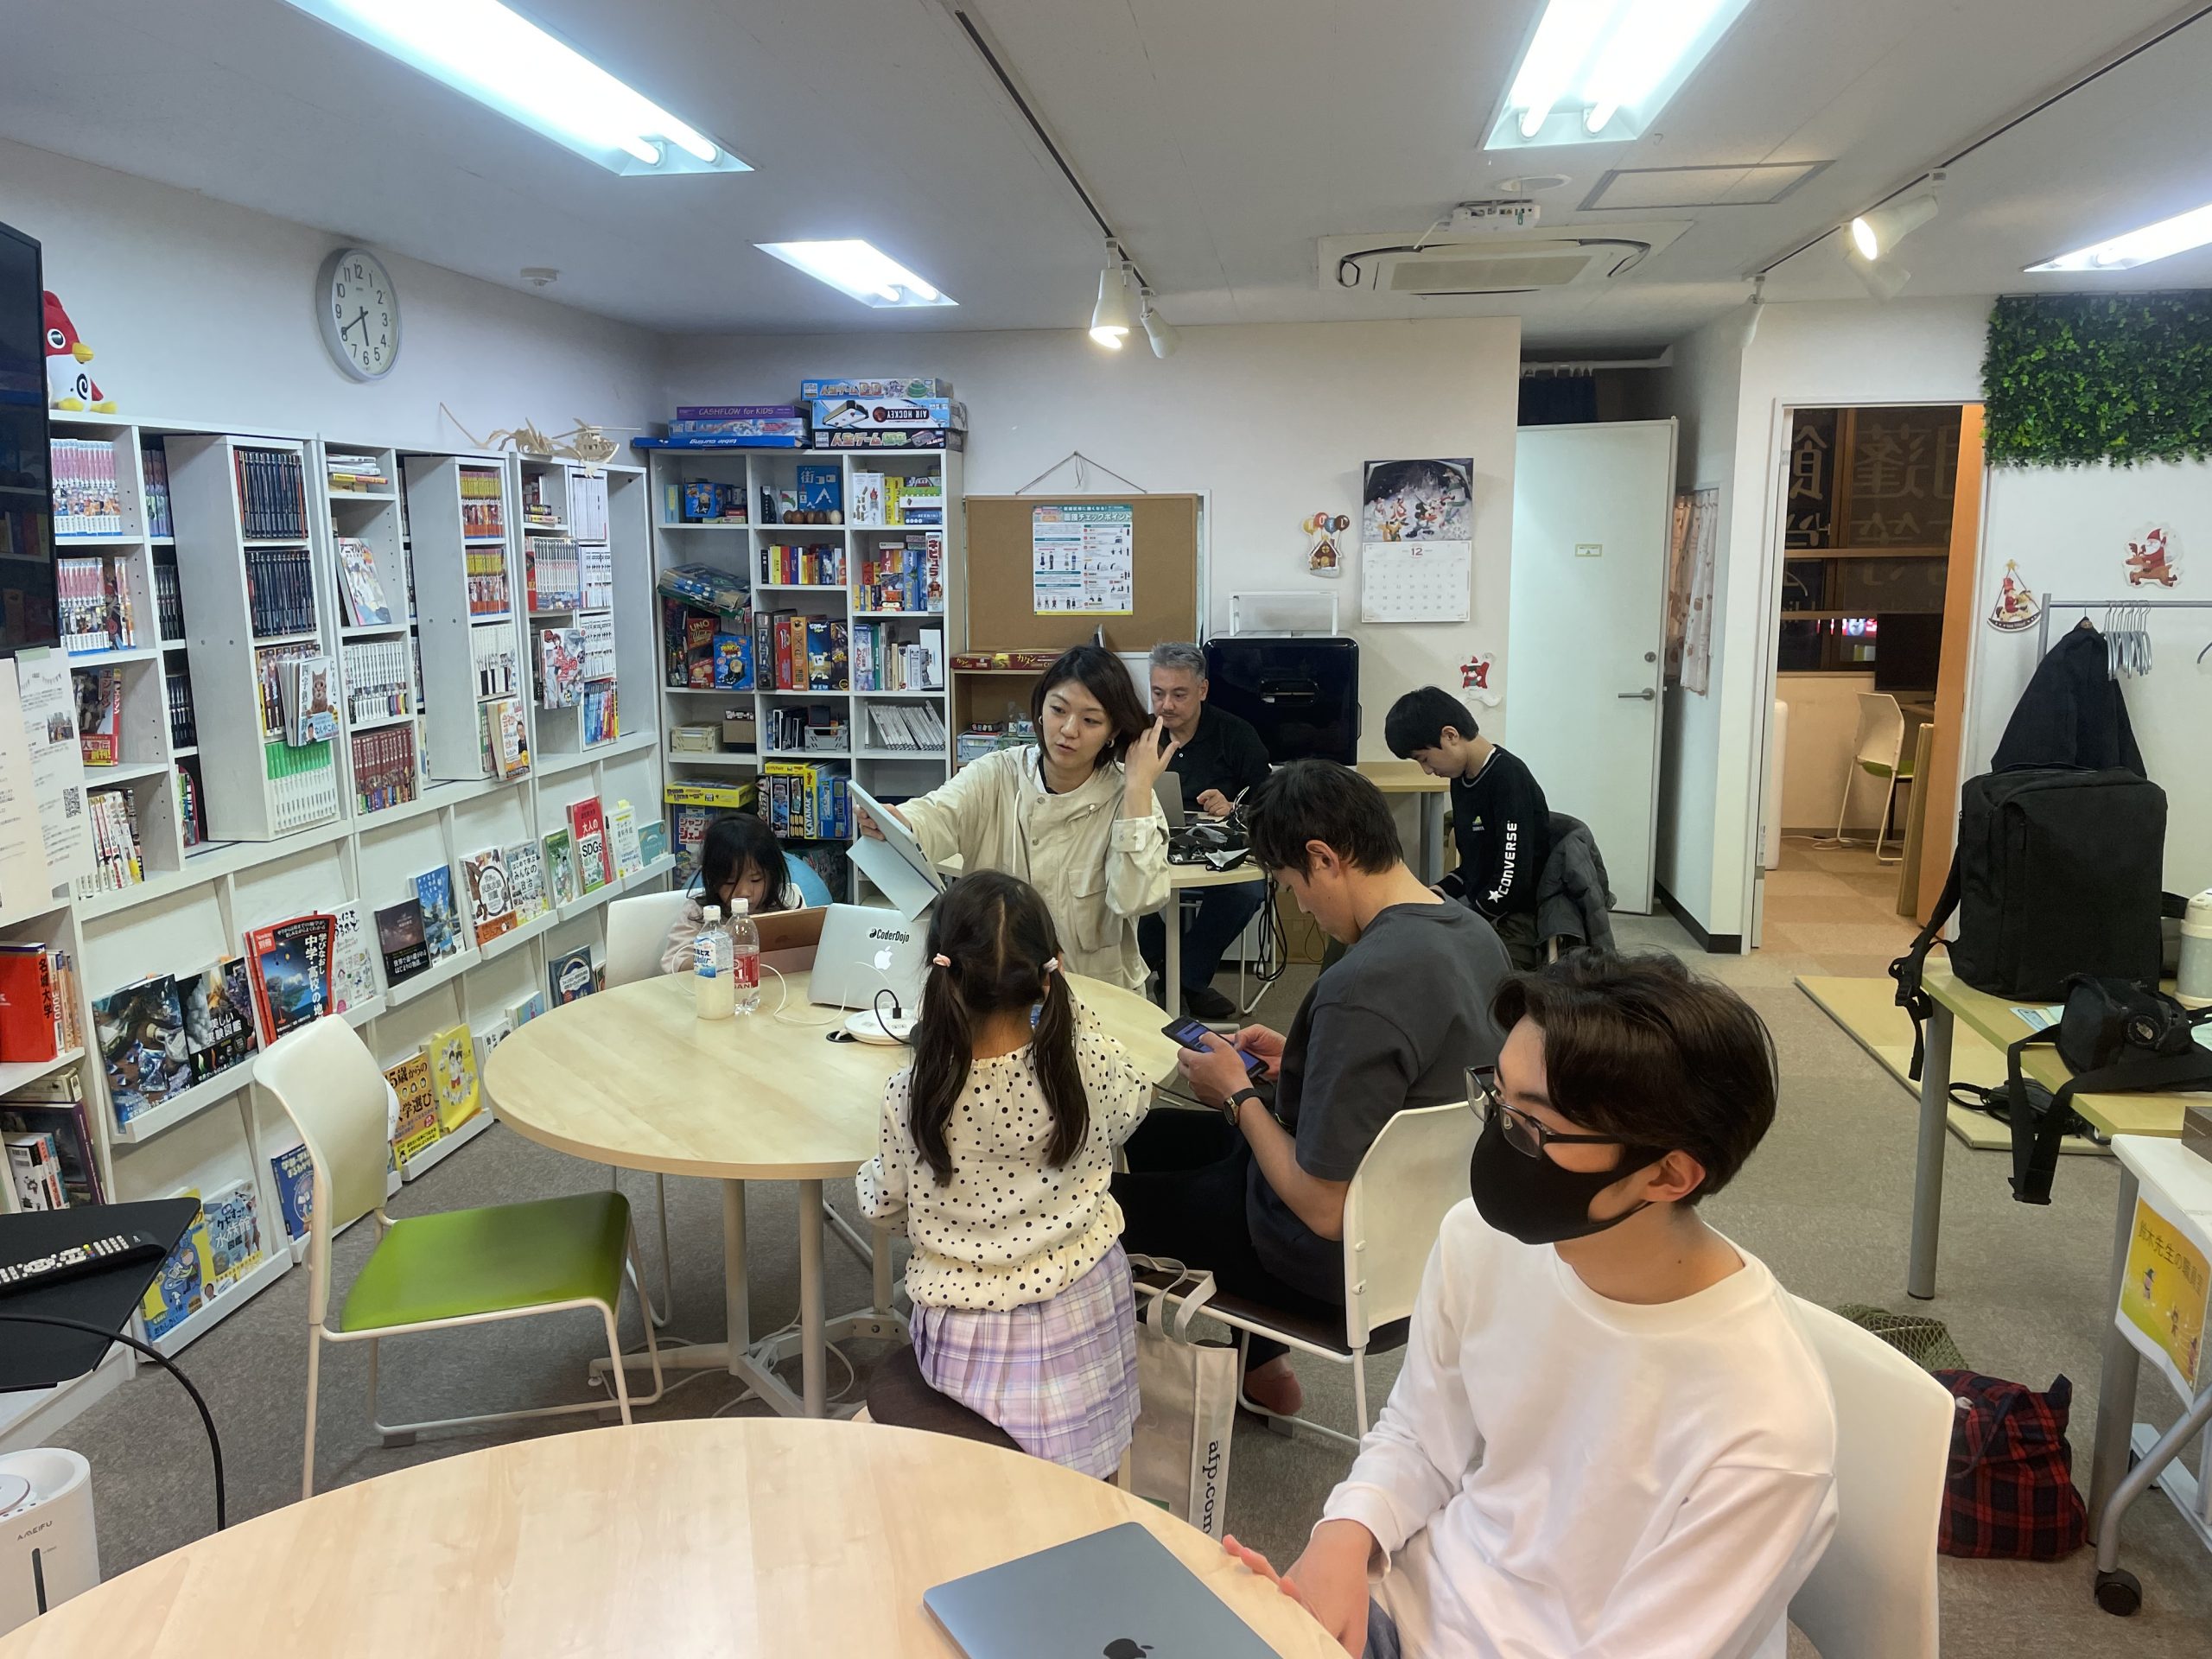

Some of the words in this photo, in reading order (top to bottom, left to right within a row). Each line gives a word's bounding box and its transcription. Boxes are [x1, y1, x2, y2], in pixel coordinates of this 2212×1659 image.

[344, 268, 351, 283] 11
[354, 264, 363, 279] 12
[369, 272, 372, 288] 1
[337, 283, 346, 298] 10
[377, 290, 383, 304] 2
[335, 304, 341, 318] 9
[381, 313, 388, 327] 3
[341, 327, 347, 341] 8
[381, 334, 386, 347] 4
[352, 344, 357, 358] 7
[363, 352, 369, 365] 6
[374, 347, 380, 361] 5
[887, 410, 912, 419] HOCKEY
[915, 410, 927, 419] AIR
[1411, 548, 1423, 556] 12
[689, 620, 710, 632] UNO
[1016, 654, 1036, 668] カタン
[101, 669, 111, 709] エジソン
[805, 798, 815, 837] KAYANAK
[582, 841, 603, 857] SDGs
[1498, 823, 1517, 895] CONVERSE
[514, 864, 537, 880] みんなの
[876, 929, 910, 944] CoderDojo
[318, 933, 327, 975] 学びなおし
[305, 935, 325, 1019] 中学・高校の地
[52, 992, 62, 1020] 3000
[398, 1090, 432, 1122] 学選び
[216, 1216, 251, 1249] 水族館
[1202, 1440, 1221, 1535] afp.com
[16, 1520, 54, 1541] AMEIFU
